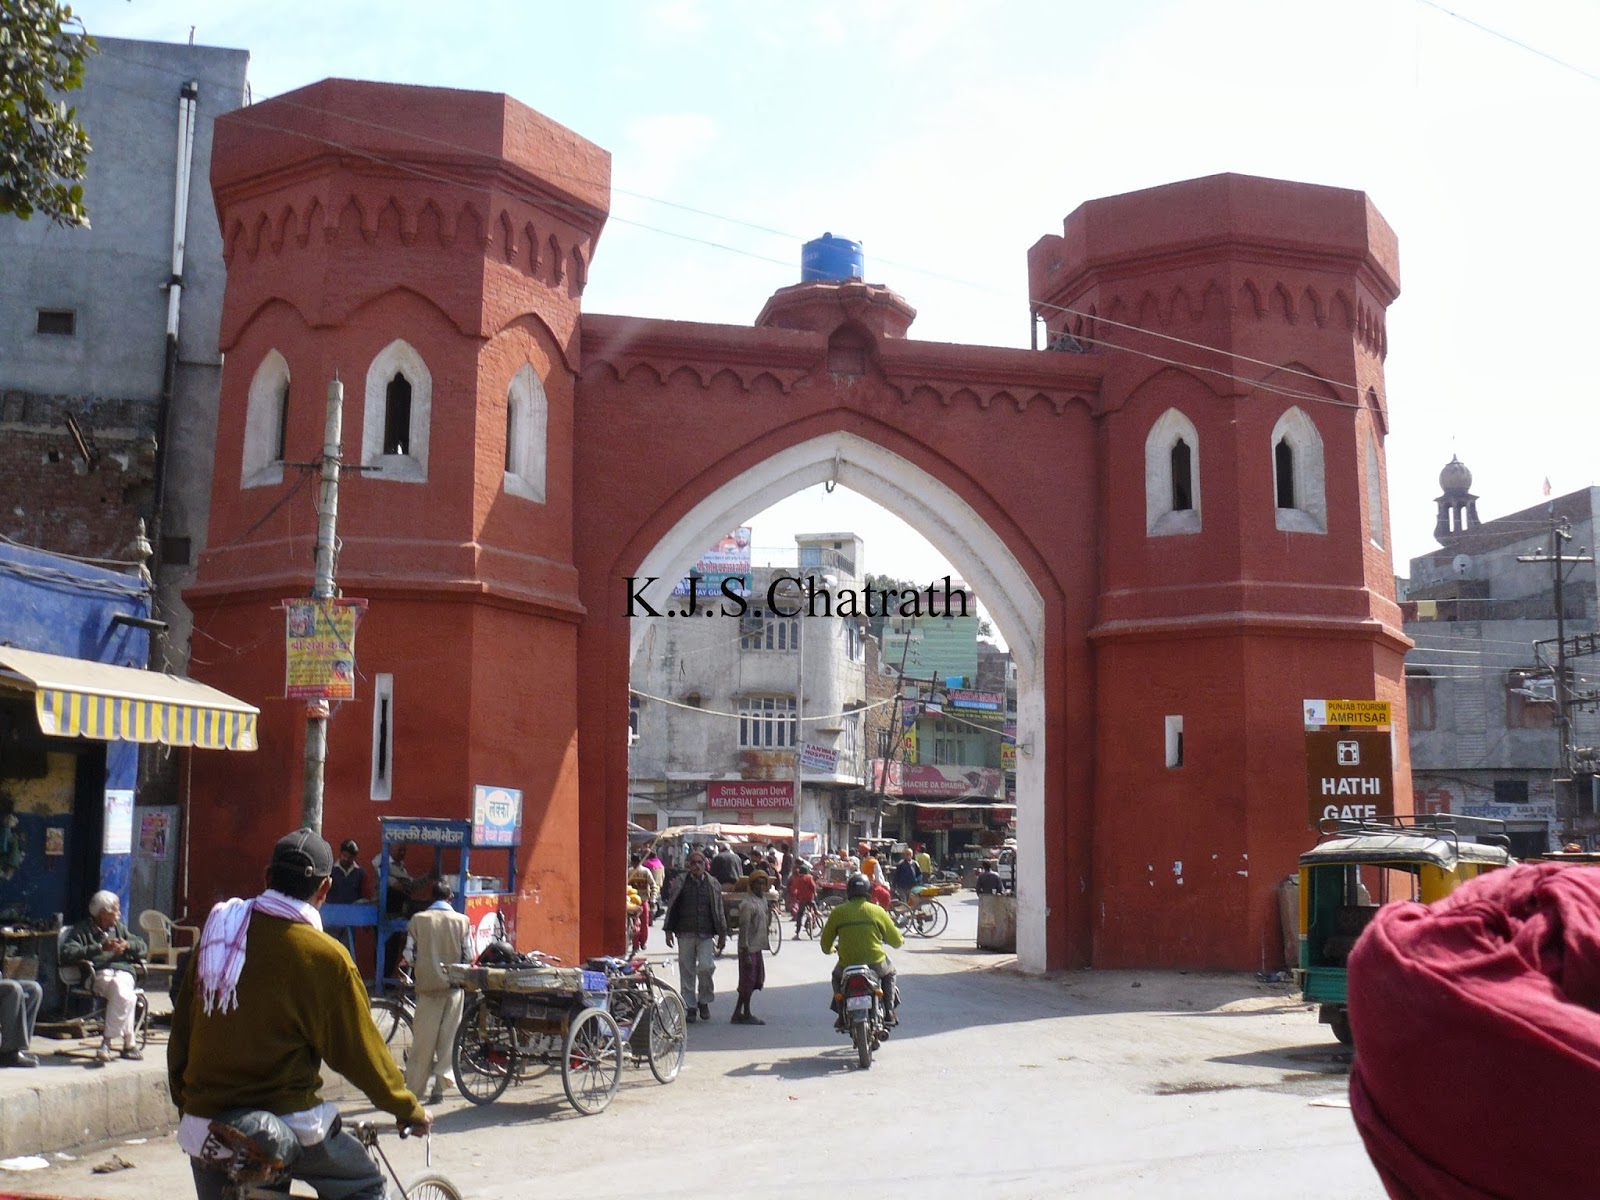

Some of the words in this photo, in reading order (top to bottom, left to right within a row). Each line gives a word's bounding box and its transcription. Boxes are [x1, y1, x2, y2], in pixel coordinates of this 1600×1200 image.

[1328, 703, 1356, 711] PUNJAB
[1357, 703, 1387, 711] TOURISM
[1330, 712, 1387, 723] AMRITSAR
[804, 749, 837, 762] HOSPITAL
[806, 744, 837, 757] KANWAR
[720, 785, 737, 796] Smt.
[740, 785, 768, 796] Swaran
[770, 785, 787, 796] Devi
[1321, 777, 1381, 795] HATHI
[711, 797, 755, 807] MEMORIAL
[757, 797, 794, 807] HOSPITAL
[1323, 804, 1377, 822] GATE
